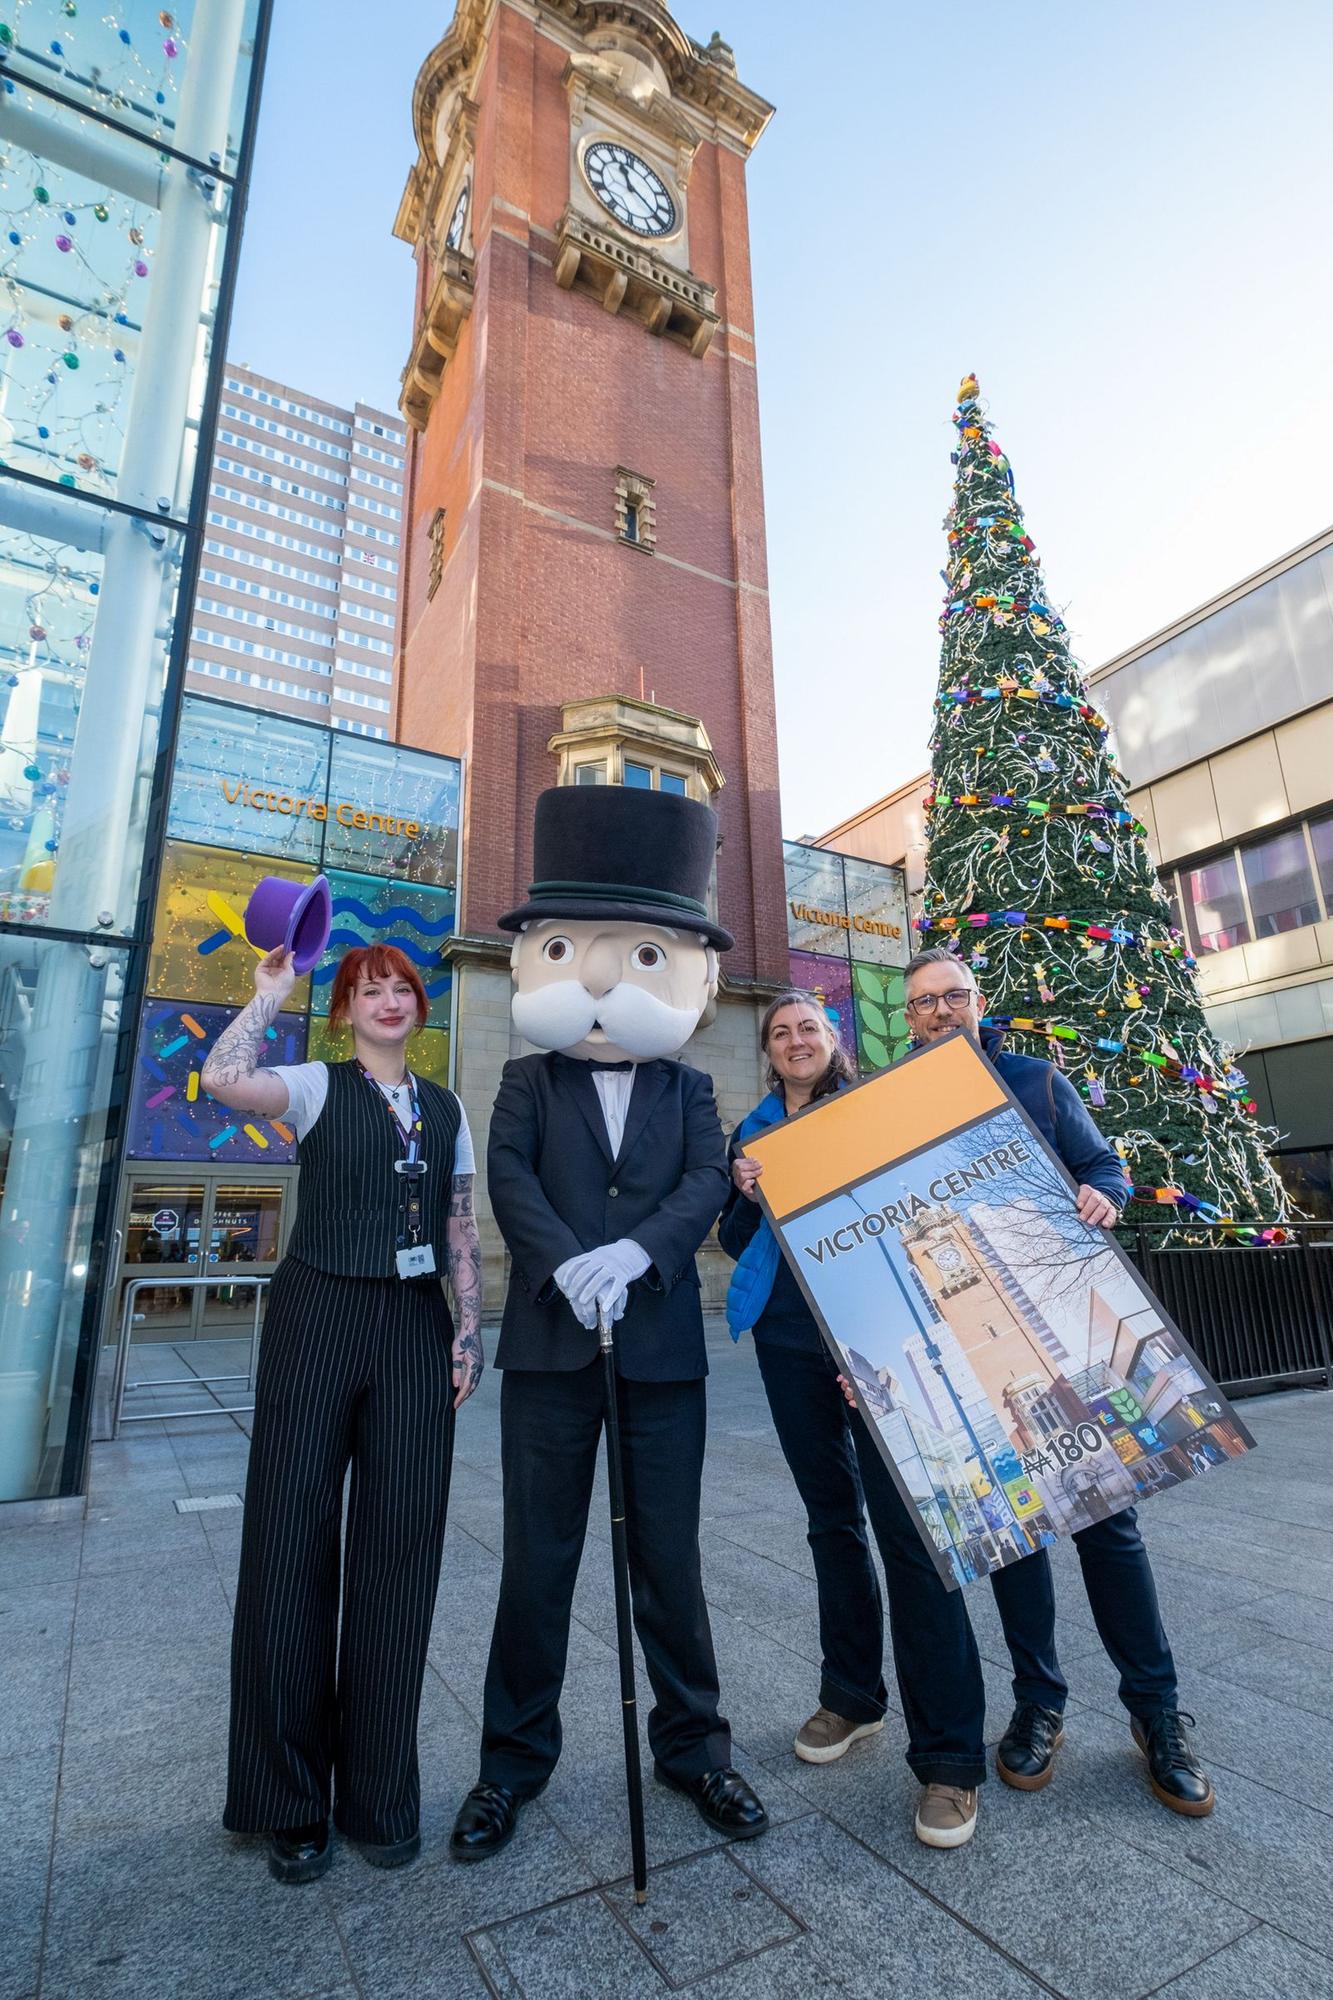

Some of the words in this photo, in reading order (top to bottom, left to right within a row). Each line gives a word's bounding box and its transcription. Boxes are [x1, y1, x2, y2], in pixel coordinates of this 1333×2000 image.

[221, 779, 328, 821] Victoria
[336, 803, 421, 839] Centre
[790, 901, 851, 929] Victoria
[853, 912, 902, 939] Centre
[804, 1193, 931, 1264] VICTORIA
[928, 1139, 1031, 1203] CENTRE
